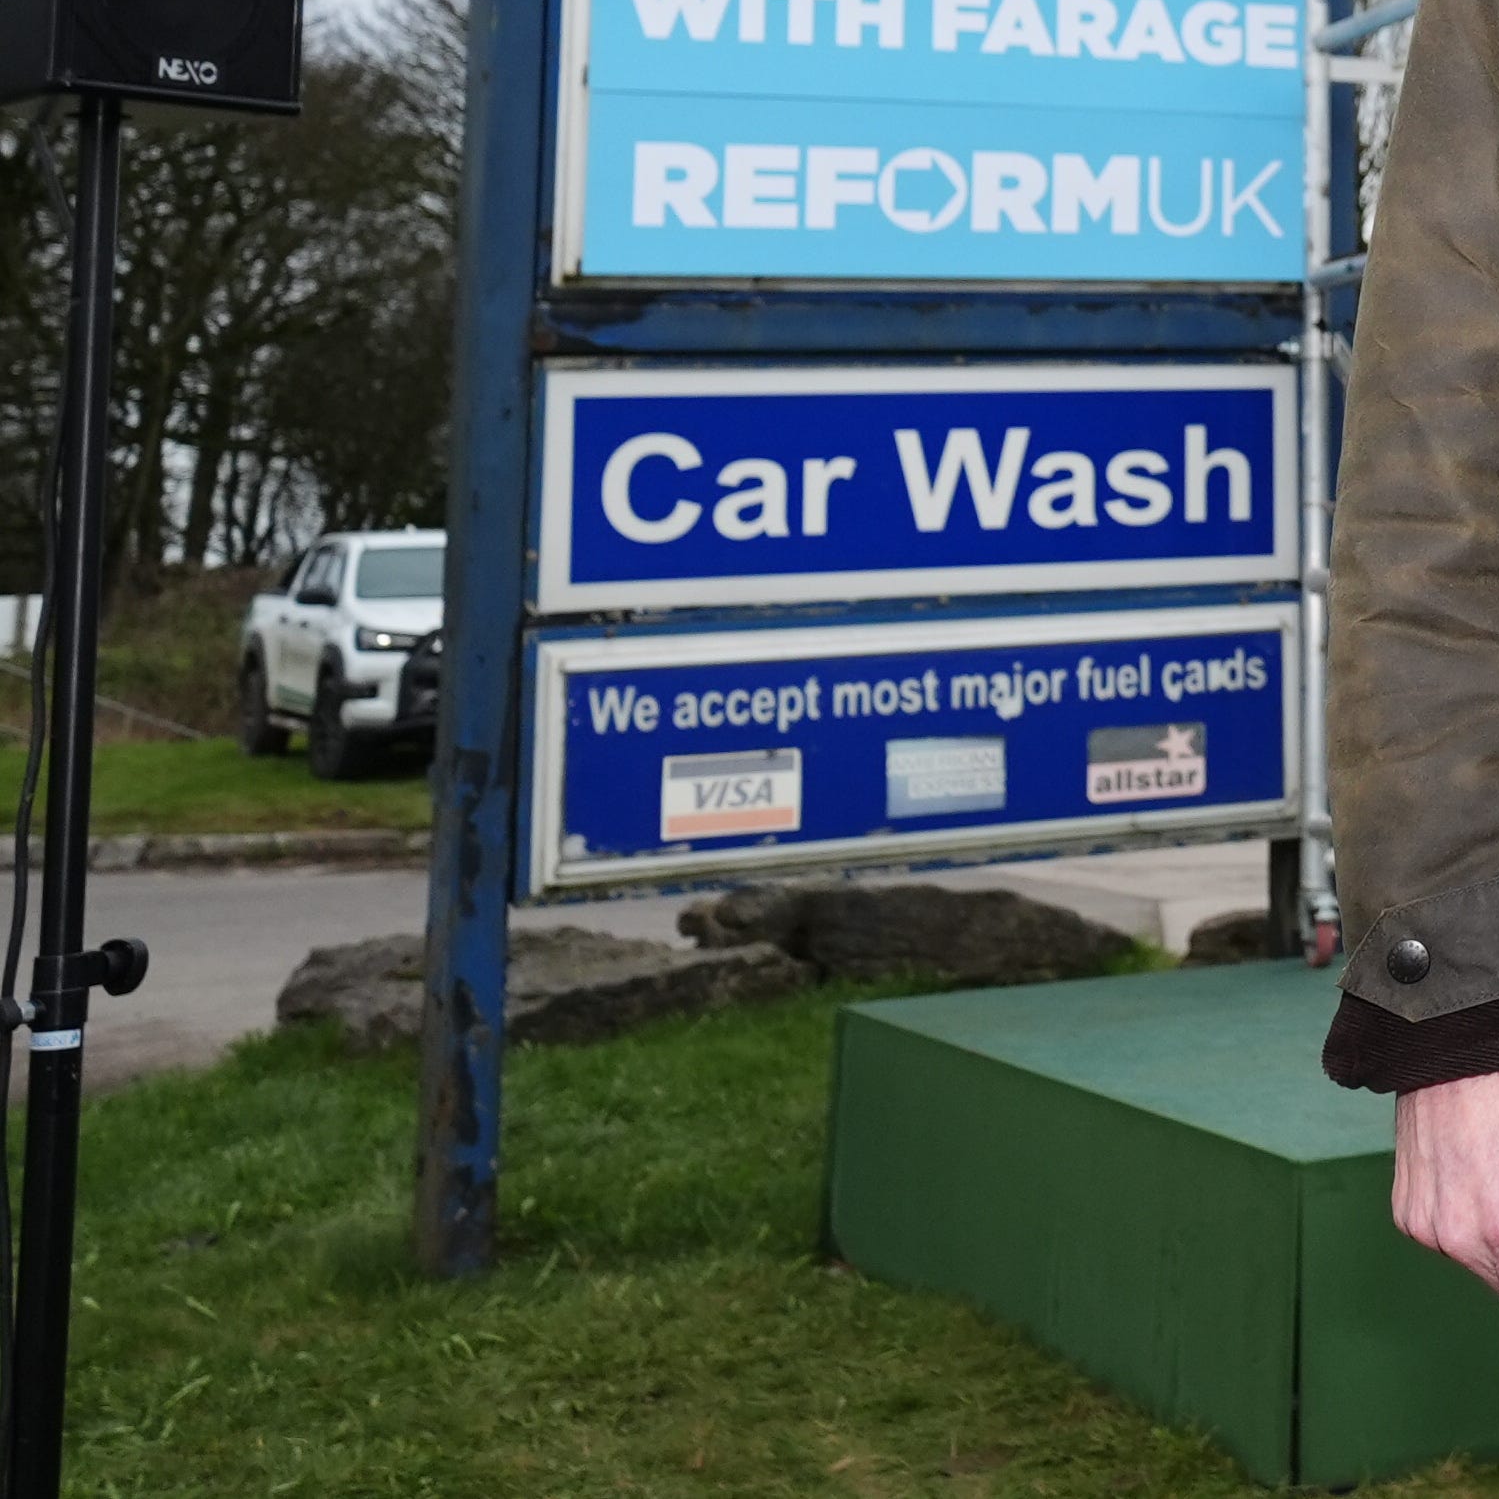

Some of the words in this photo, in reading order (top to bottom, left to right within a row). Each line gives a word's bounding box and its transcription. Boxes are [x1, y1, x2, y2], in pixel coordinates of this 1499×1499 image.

[158, 56, 218, 85] NEXO
[600, 432, 857, 544] Car
[893, 423, 1253, 533] Wash
[588, 685, 660, 735] We
[672, 675, 821, 733] accept
[832, 667, 940, 718] most
[951, 661, 1067, 720] major
[1076, 653, 1151, 701] fuel
[1161, 648, 1266, 701] cards
[692, 777, 774, 810] VISA
[1095, 767, 1198, 793] allstar
